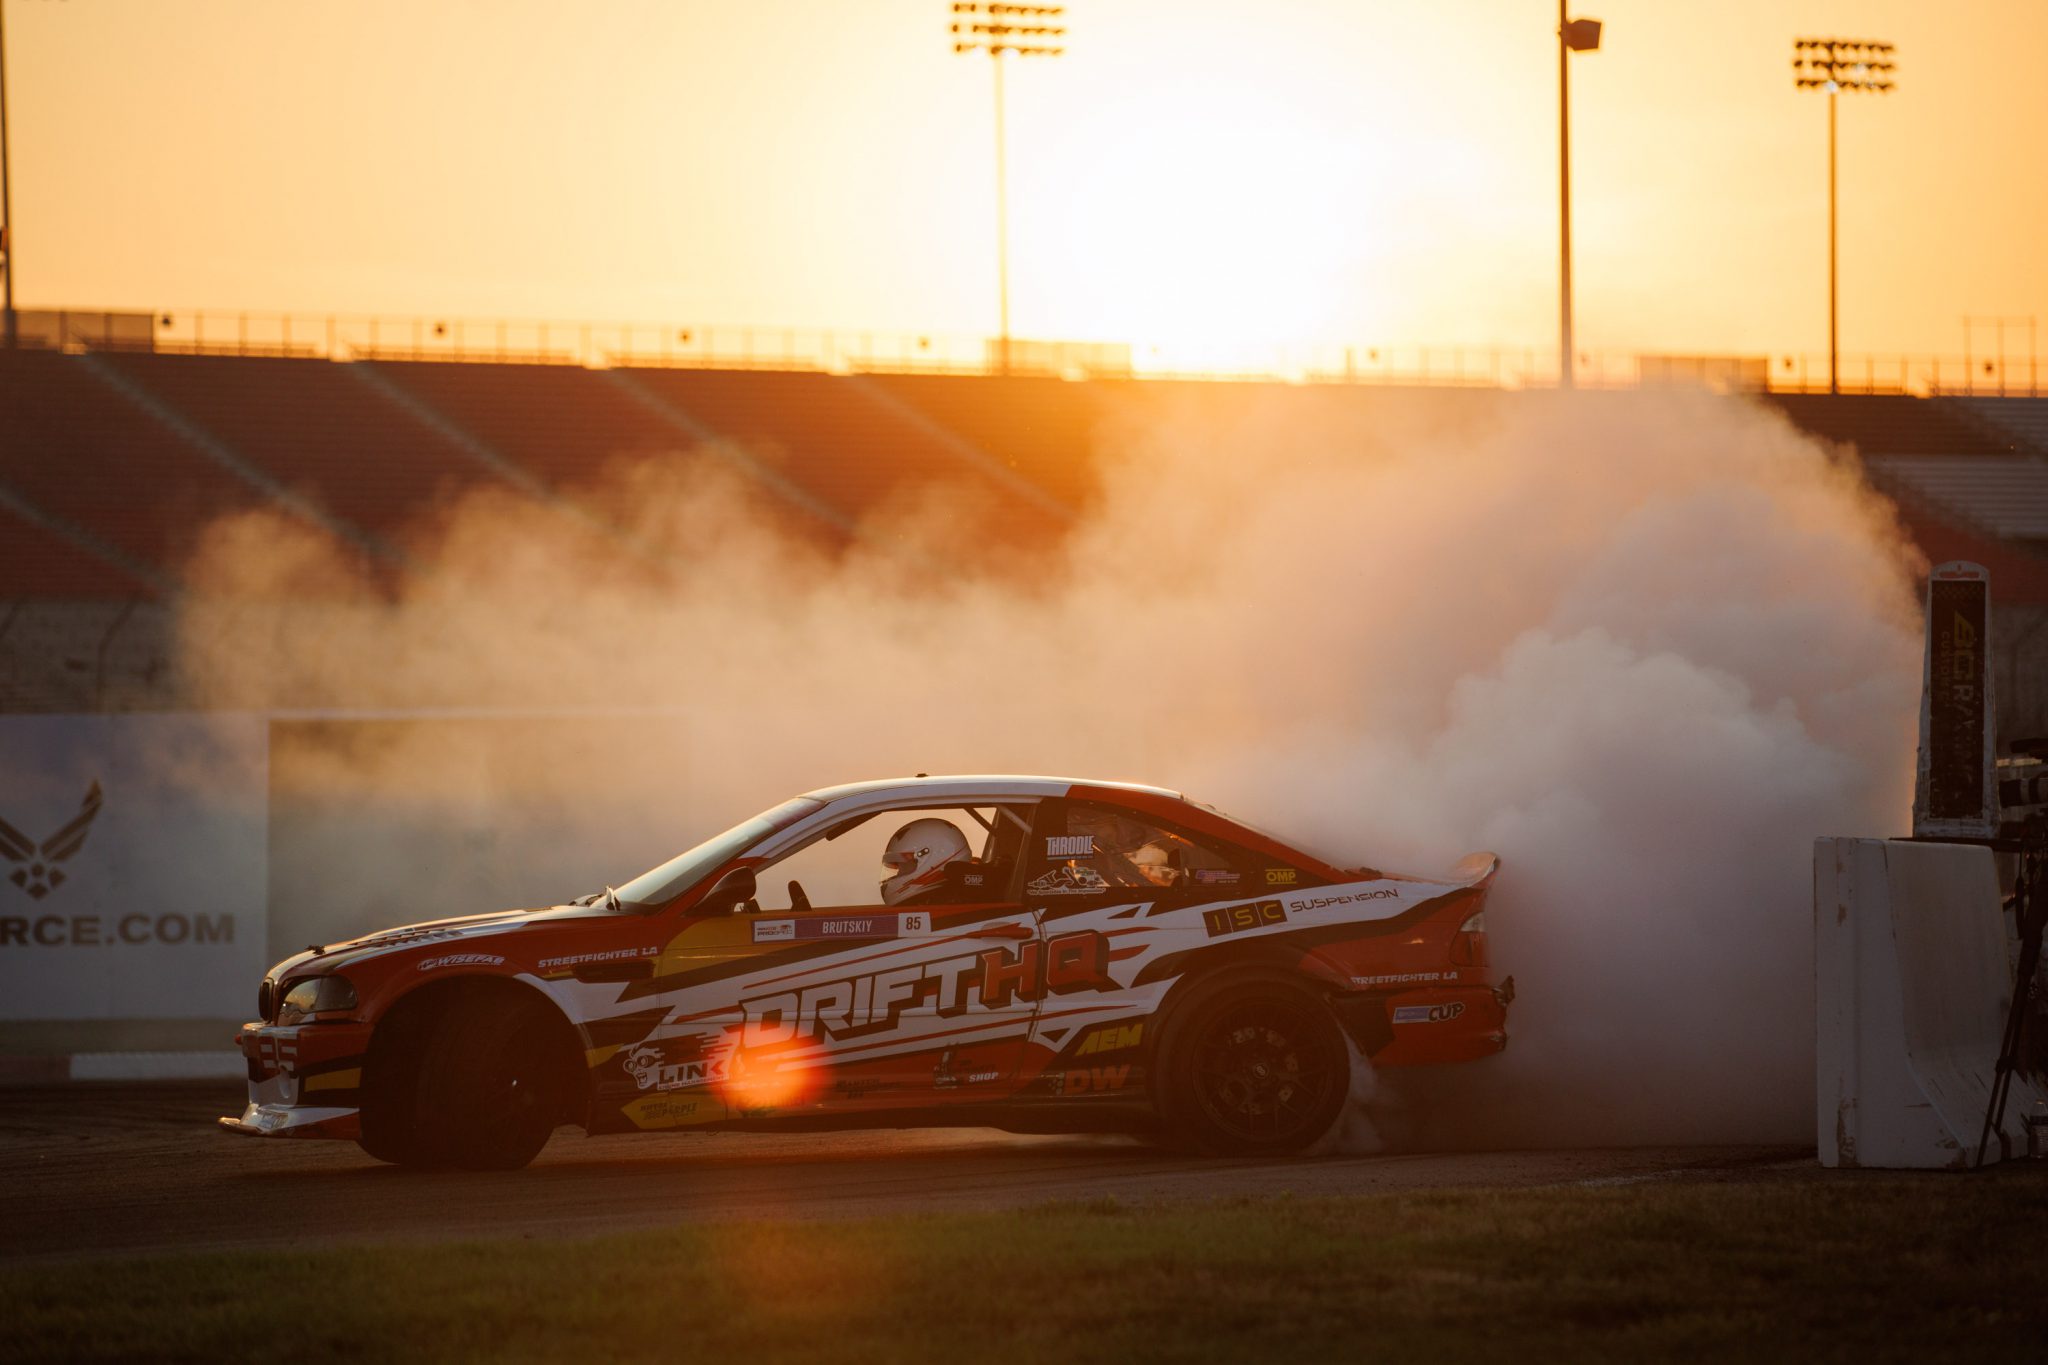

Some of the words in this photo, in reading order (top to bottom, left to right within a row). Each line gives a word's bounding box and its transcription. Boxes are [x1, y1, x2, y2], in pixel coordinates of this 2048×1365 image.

[1266, 870, 1297, 883] OMP
[1289, 888, 1399, 912] SUSPENSION
[822, 919, 873, 934] BRUTSKIY
[906, 916, 921, 930] 85
[538, 948, 638, 968] STREETFIGHTER
[642, 946, 658, 956] LA
[1443, 971, 1458, 980] LA
[1428, 1002, 1465, 1022] CUP
[1074, 1023, 1144, 1056] AEM
[659, 1060, 725, 1084] LINK
[968, 1071, 999, 1083] SHOP
[1065, 1064, 1131, 1095] DW
